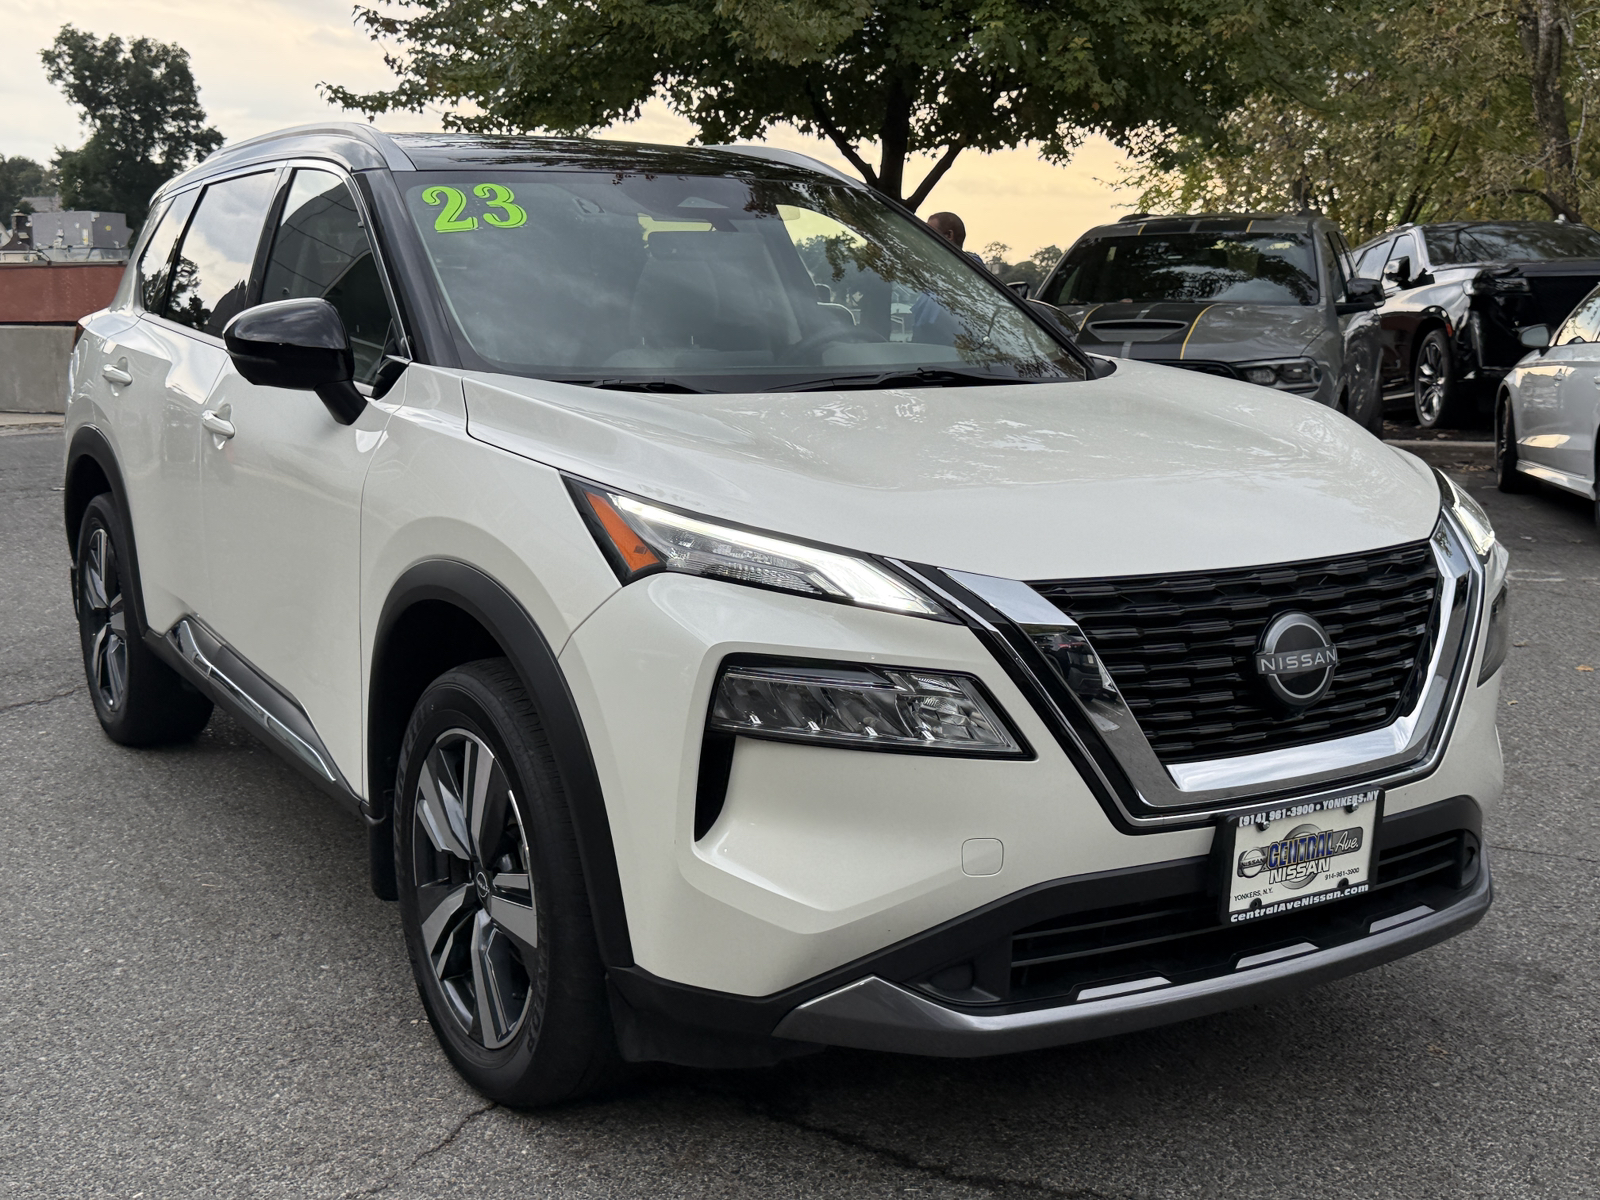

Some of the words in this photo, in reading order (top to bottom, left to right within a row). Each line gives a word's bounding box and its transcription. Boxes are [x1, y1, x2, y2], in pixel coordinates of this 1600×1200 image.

[422, 183, 527, 234] 23
[1260, 648, 1337, 672] NISSAN
[1268, 803, 1315, 821] 961-3900
[1267, 829, 1334, 870] CENTRAL
[1269, 857, 1331, 885] NISSAN
[1230, 884, 1369, 922] CentralAveNissan.com
